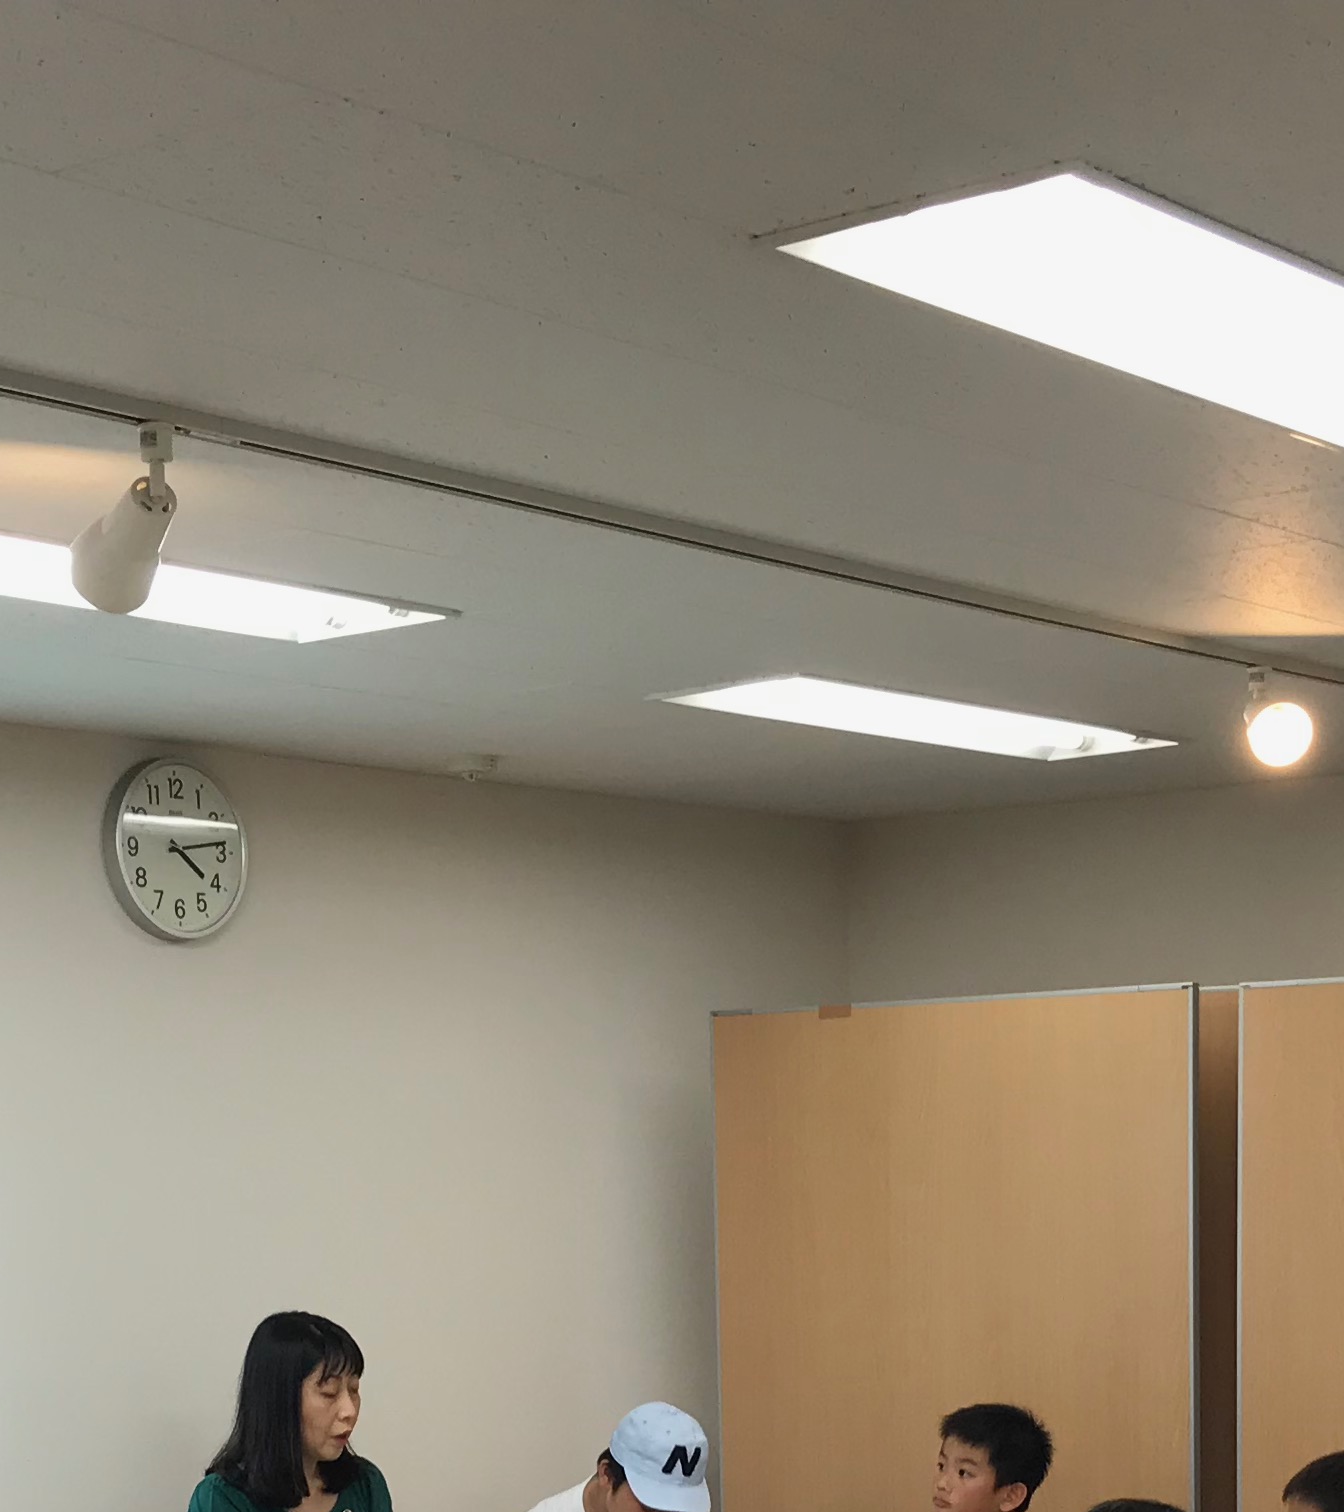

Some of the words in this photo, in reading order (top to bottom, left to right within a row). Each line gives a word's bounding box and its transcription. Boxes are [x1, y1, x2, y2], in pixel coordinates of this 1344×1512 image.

[147, 784, 160, 806] 11
[168, 778, 184, 799] 12
[195, 788, 201, 809] 1
[127, 836, 139, 857] 9
[215, 843, 227, 863] 3
[135, 866, 148, 888] 8
[210, 873, 222, 893] 4
[154, 890, 164, 910] 7
[174, 899, 186, 919] 6
[196, 893, 207, 913] 5
[661, 1444, 702, 1477] N
